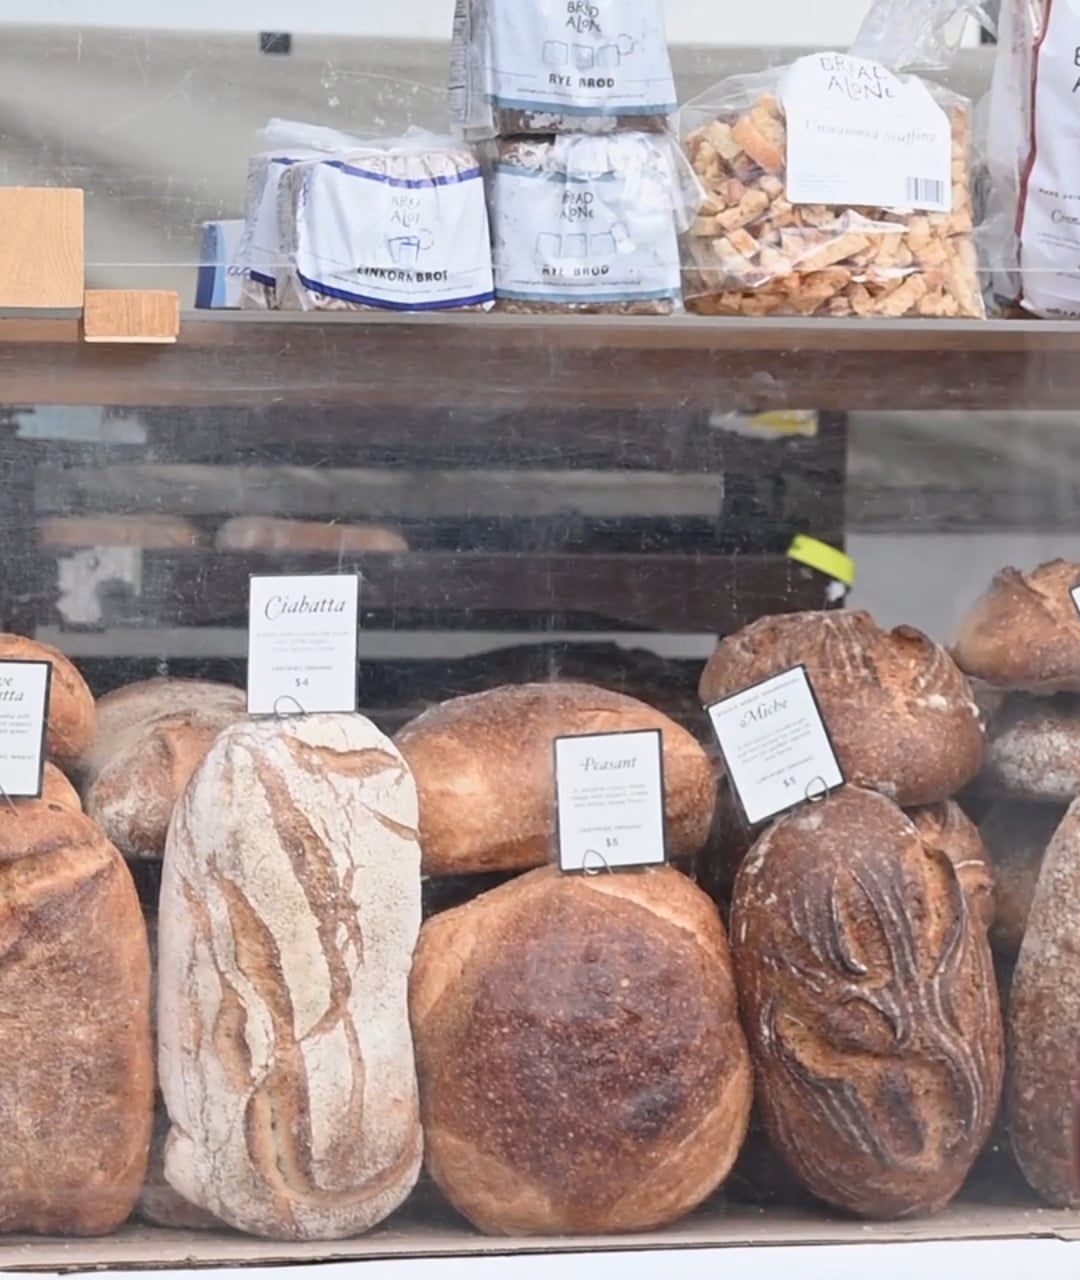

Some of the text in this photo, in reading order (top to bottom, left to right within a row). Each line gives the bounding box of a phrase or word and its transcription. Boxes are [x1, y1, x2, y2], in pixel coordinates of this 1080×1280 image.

[416, 268, 449, 284] BROT
[264, 594, 347, 621] Ciabatta
[295, 677, 309, 688] $4
[740, 699, 789, 729] Miche
[580, 756, 637, 772] Peasant
